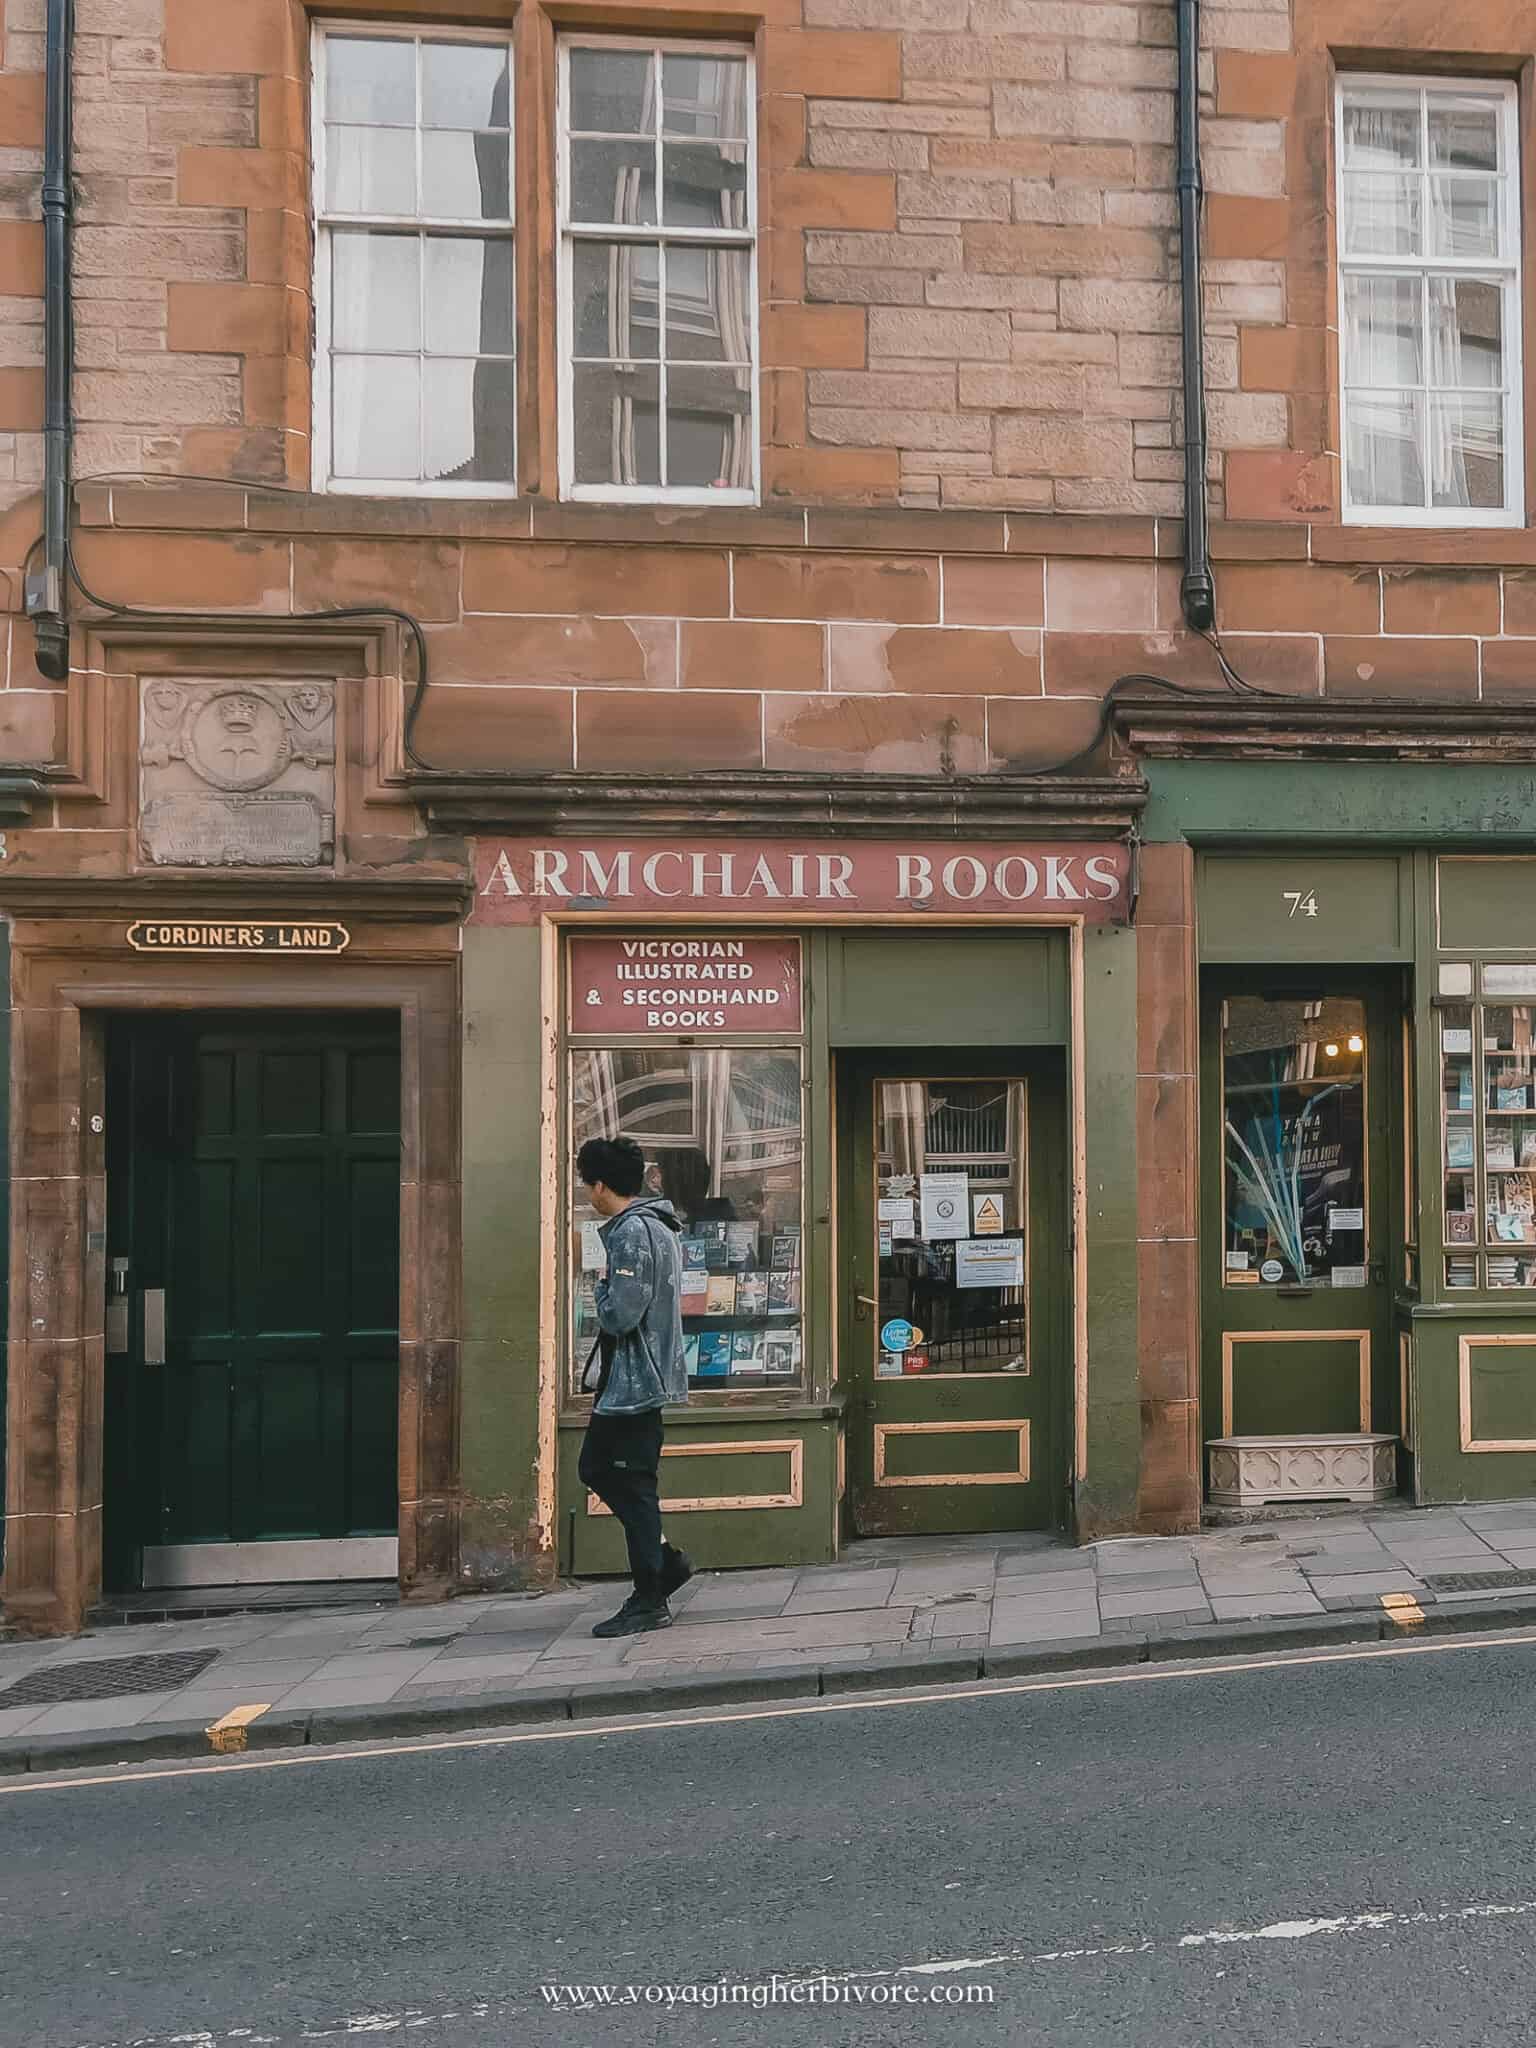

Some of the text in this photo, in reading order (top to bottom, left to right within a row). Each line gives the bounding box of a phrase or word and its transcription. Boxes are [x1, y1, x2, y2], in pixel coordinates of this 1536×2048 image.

[480, 849, 1121, 901] ARMCHAIR BOOKS
[1283, 889, 1318, 918] 74
[146, 926, 331, 946] CORDINER'S LAND
[623, 941, 744, 958] VICTORIAN
[617, 964, 753, 980] ILLUSTRATED
[586, 988, 780, 1005] & SECONDHAND
[647, 1011, 725, 1026] BOOKS
